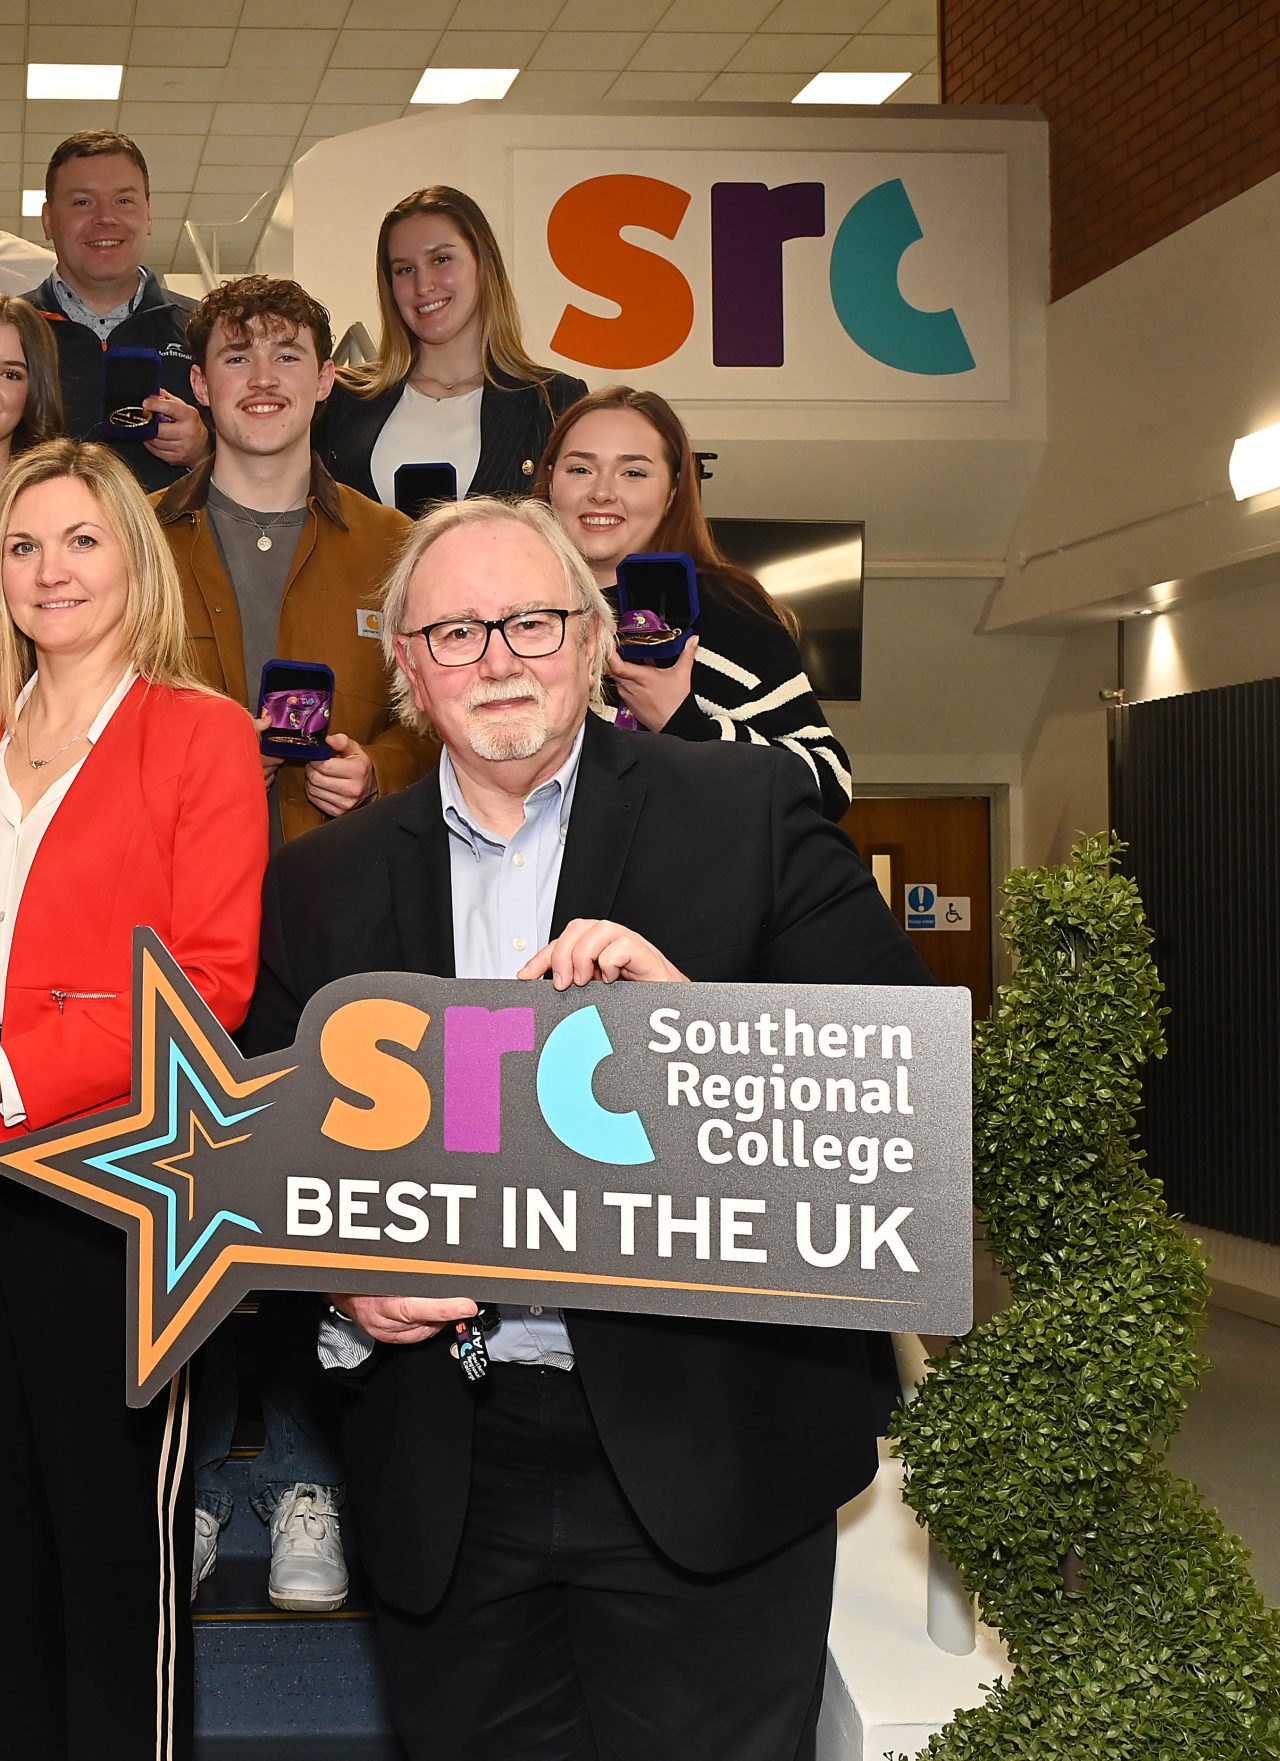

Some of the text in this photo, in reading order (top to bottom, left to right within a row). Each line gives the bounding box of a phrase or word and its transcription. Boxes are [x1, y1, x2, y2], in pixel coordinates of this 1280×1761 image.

[547, 174, 976, 375] src
[648, 1007, 914, 1060] Southern
[320, 998, 656, 1166] src
[667, 1061, 914, 1123] Regional
[696, 1118, 914, 1185] College
[286, 1175, 921, 1273] BEST IN THE UK
